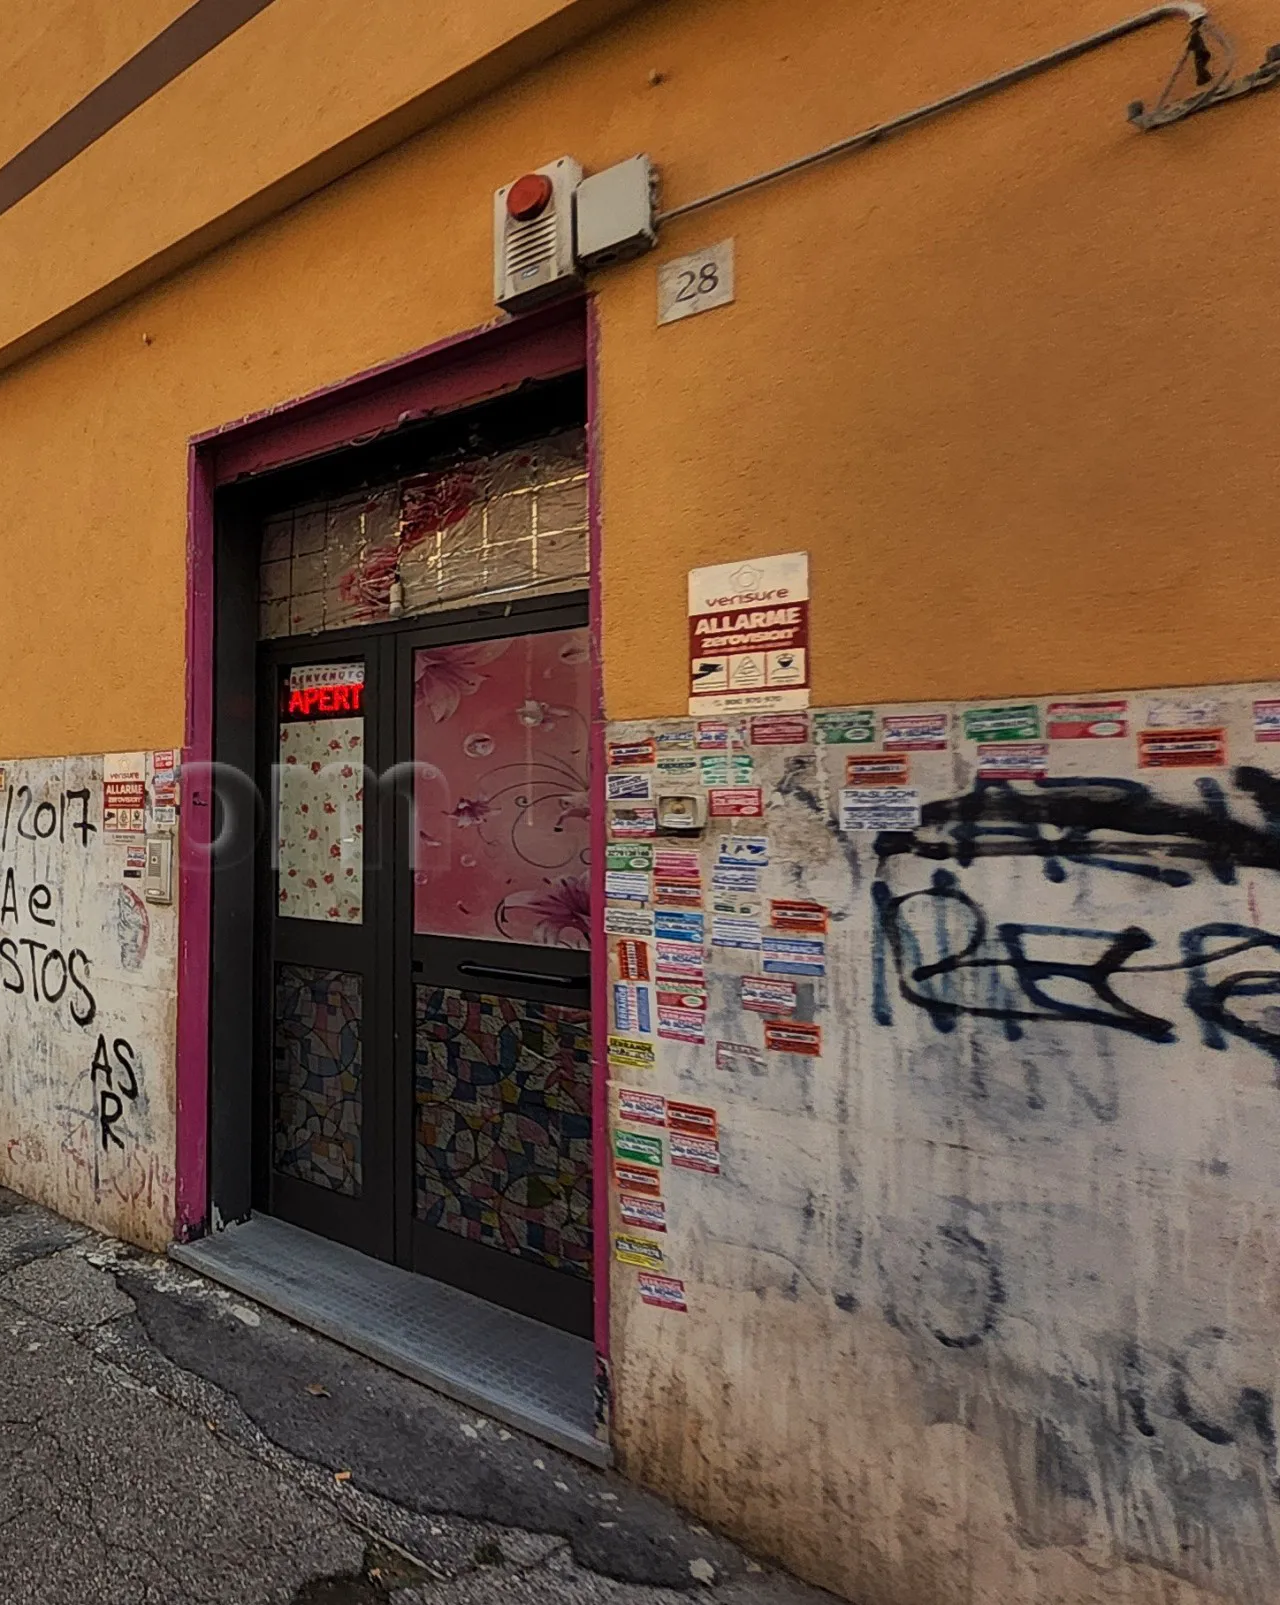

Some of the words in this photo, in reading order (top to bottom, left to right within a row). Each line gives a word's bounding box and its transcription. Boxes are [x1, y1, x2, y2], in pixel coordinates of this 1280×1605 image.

[675, 262, 719, 303] 28
[705, 587, 789, 607] verisure
[694, 607, 803, 636] ALLARME
[106, 784, 143, 796] ALLARME
[91, 1033, 140, 1101] AS
[100, 1090, 125, 1150] R
